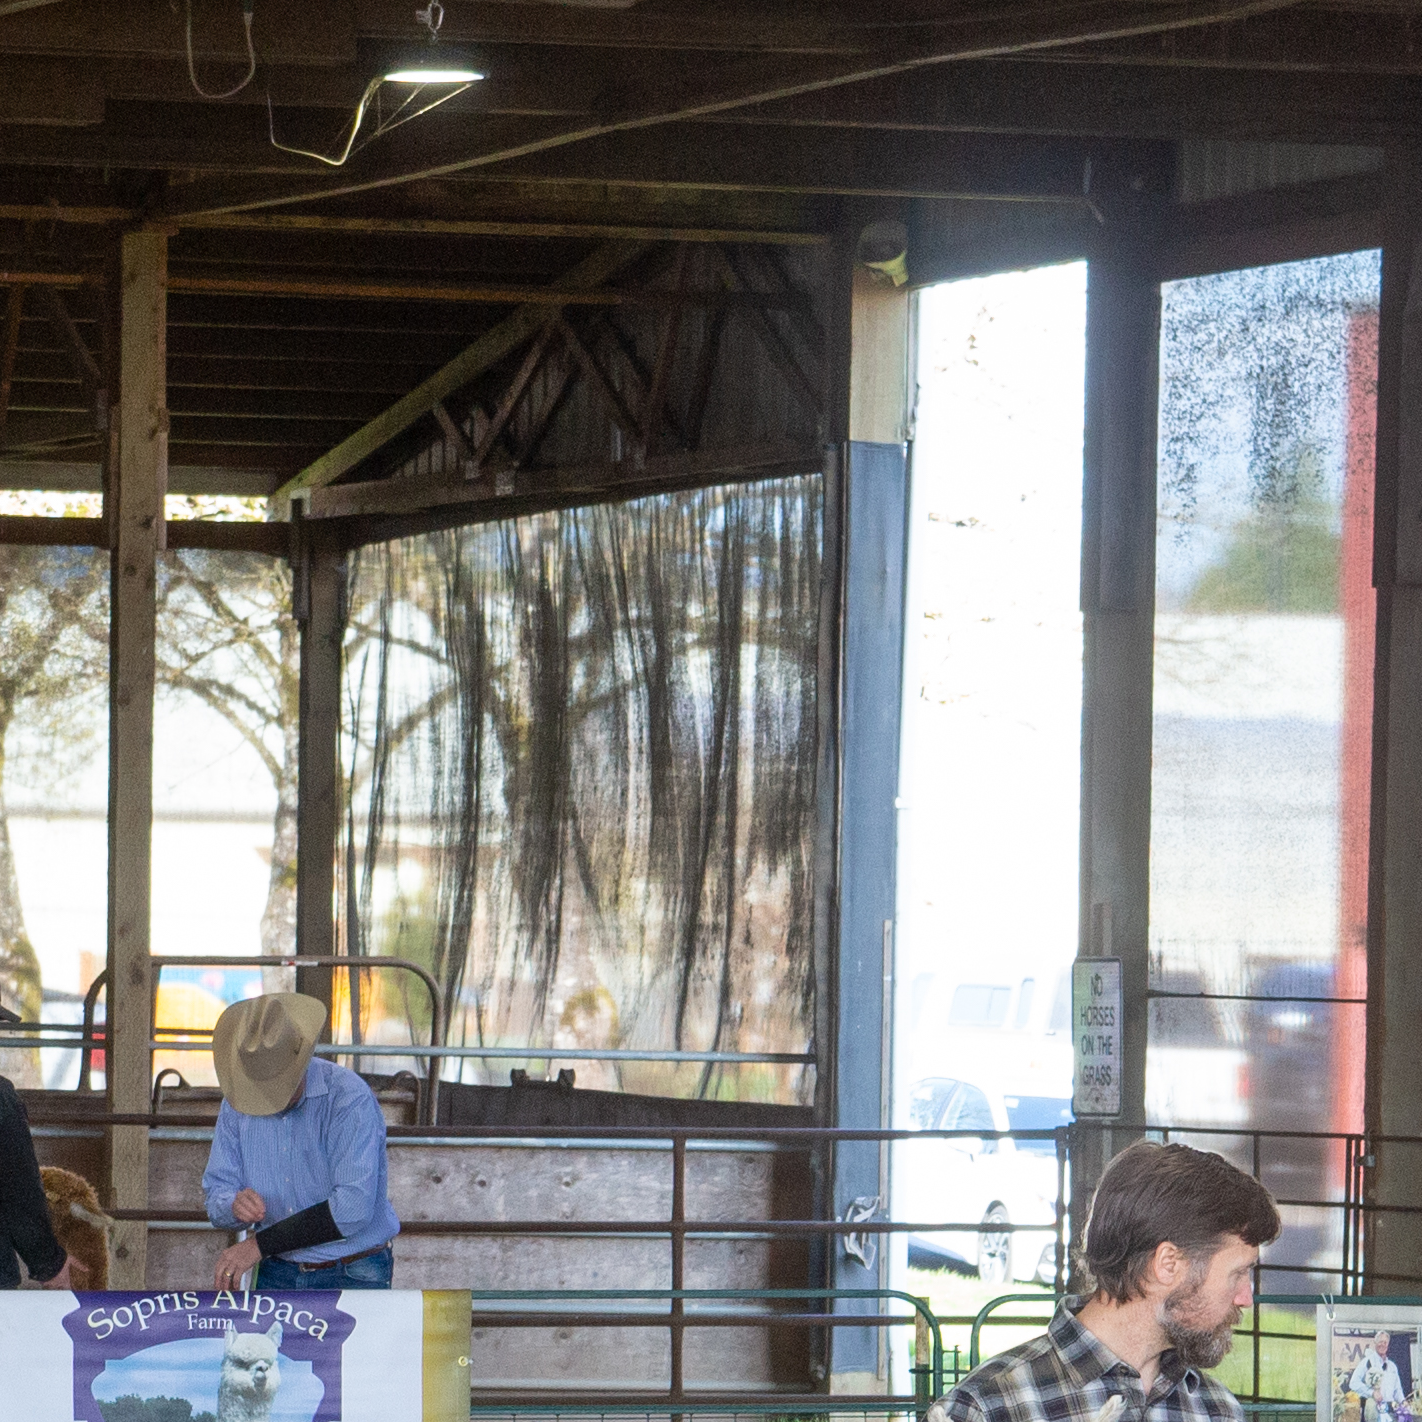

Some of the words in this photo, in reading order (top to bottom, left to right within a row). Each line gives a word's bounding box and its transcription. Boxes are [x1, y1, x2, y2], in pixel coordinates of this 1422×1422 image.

[1090, 975, 1104, 997] NO
[1080, 1006, 1116, 1027] HORSES
[1081, 1035, 1095, 1056] ON
[1097, 1035, 1113, 1056] THE
[1082, 1065, 1112, 1087] GRASS
[87, 1290, 200, 1340] Sopris
[212, 1290, 330, 1342] Alpaca
[187, 1313, 234, 1331] Farm
